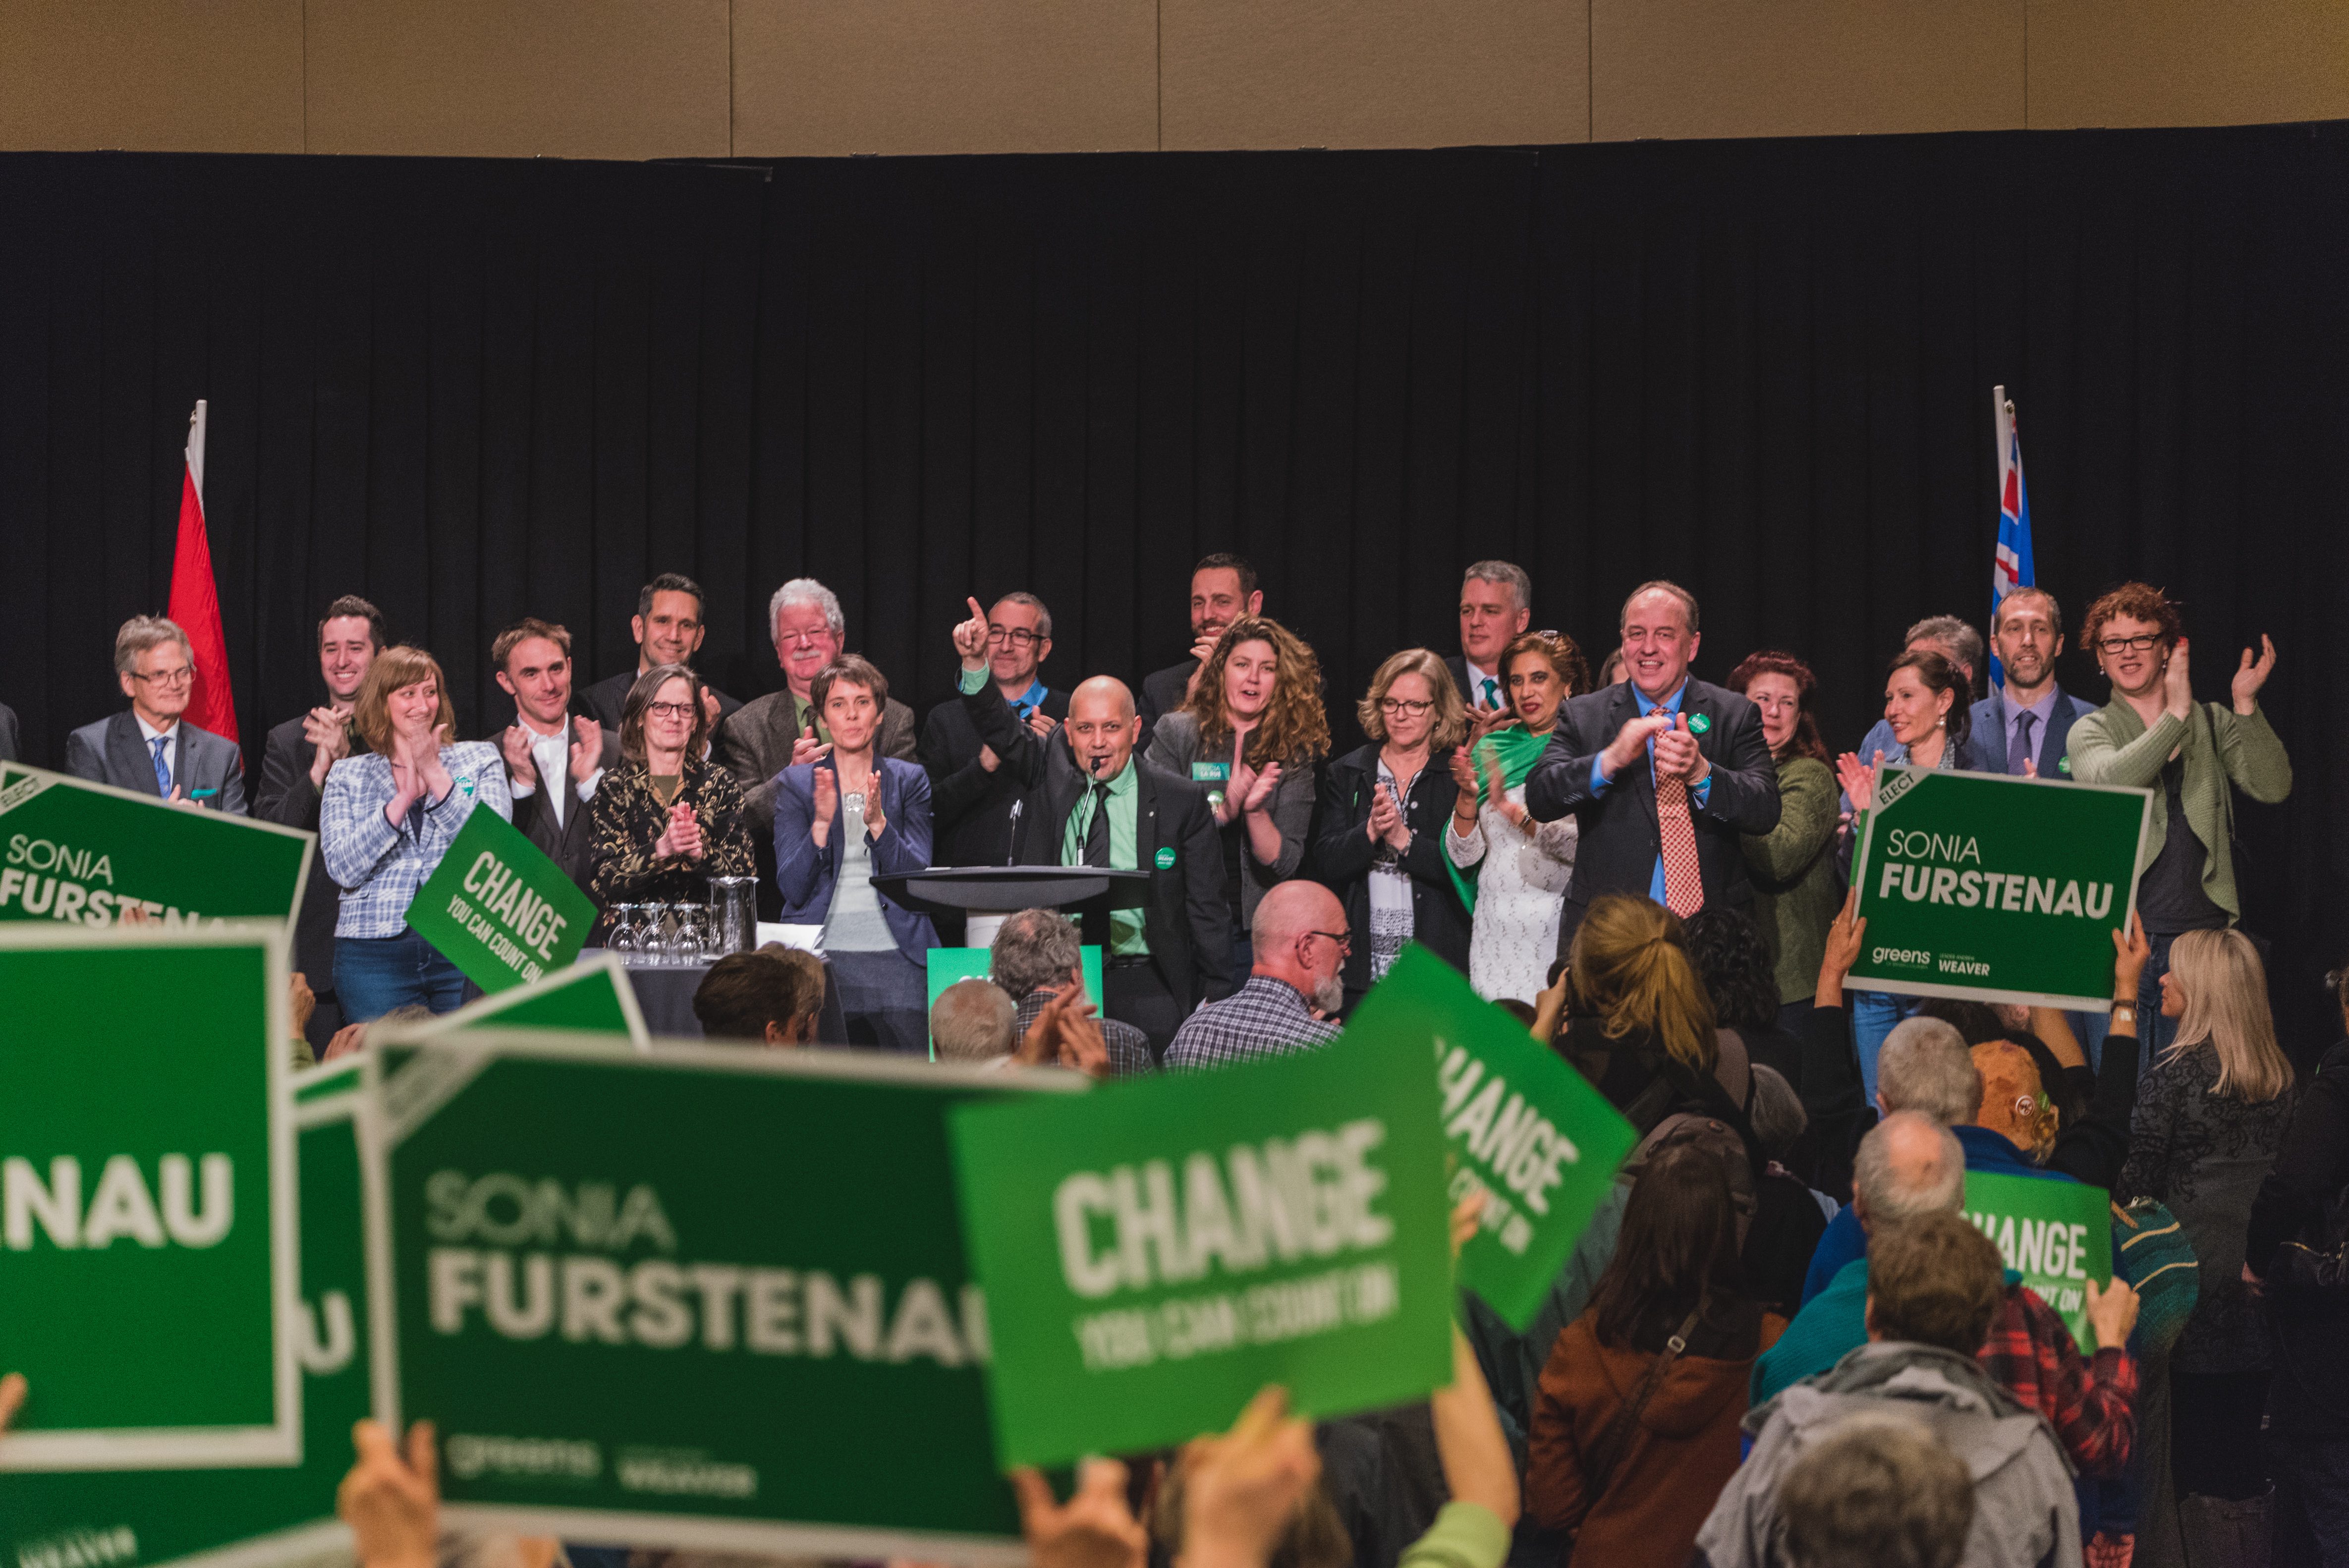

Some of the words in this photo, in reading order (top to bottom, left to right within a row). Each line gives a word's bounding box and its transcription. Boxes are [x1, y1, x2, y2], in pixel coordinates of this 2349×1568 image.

[1879, 772, 1914, 805] ELECT
[6, 834, 113, 885] SONIA
[1887, 828, 1981, 865] SONIA
[463, 850, 567, 961] CHANGE
[1879, 862, 2114, 920] FURSTENAU
[446, 894, 473, 925] YOU
[466, 913, 495, 944] CAN
[488, 932, 528, 971] COUNT
[520, 960, 544, 985] ON
[1872, 947, 1931, 964] greens
[1938, 959, 1991, 976] WEAVER
[1433, 1034, 1580, 1215] HANGE
[423, 1170, 677, 1253] SONIA
[1054, 1117, 1396, 1299] CHANGE
[2059, 1288, 2082, 1312] ON
[1072, 1307, 1160, 1373] YOU
[1161, 1294, 1236, 1362] CAN
